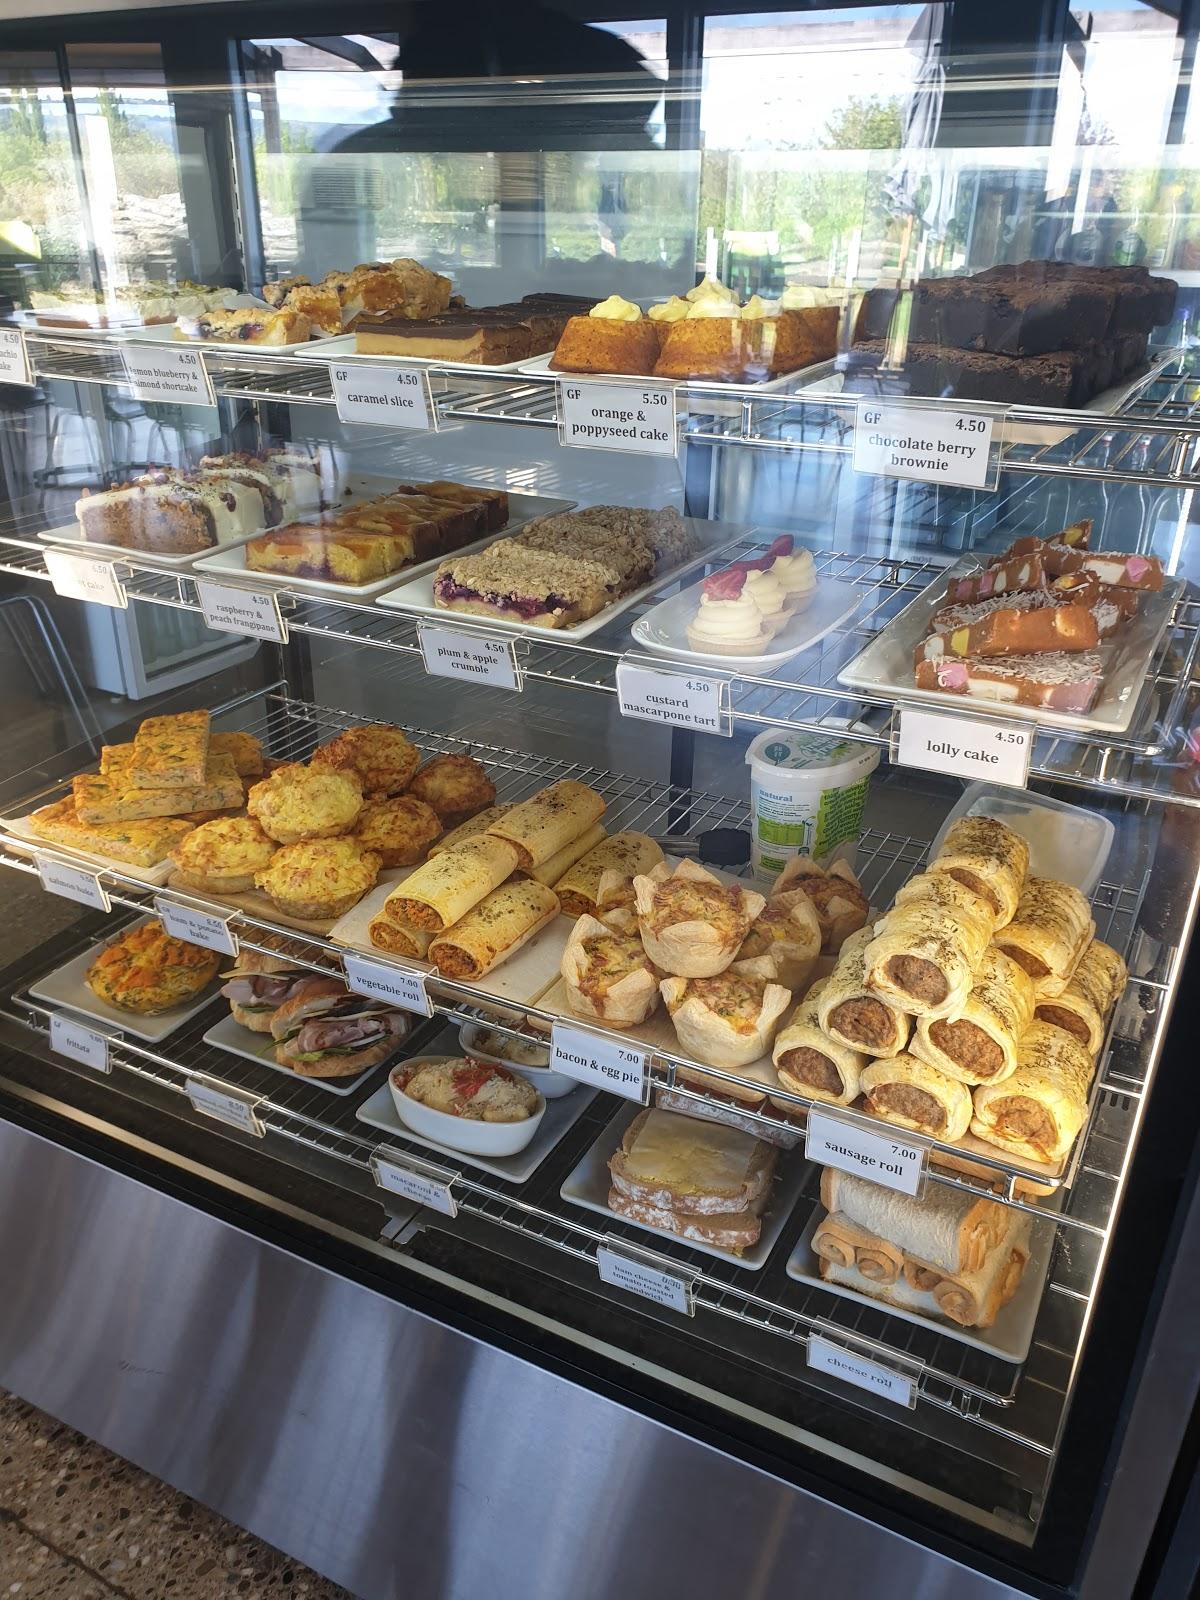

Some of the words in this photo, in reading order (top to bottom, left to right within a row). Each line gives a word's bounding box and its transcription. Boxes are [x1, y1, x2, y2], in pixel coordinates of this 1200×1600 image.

[178, 354, 197, 365] 4.50
[129, 366, 153, 377] lemon
[153, 368, 190, 380] blueberry
[192, 372, 198, 380] &
[336, 371, 348, 381] GF
[396, 373, 418, 386] 4.50
[134, 380, 160, 389] almond
[162, 381, 198, 392] shortcake
[347, 393, 389, 405] caramel
[390, 396, 414, 408] slice
[567, 389, 581, 399] GF
[642, 393, 667, 405] 5.50
[591, 408, 634, 422] orange
[636, 410, 646, 421] &
[864, 412, 881, 424] GF
[955, 419, 986, 433] 4.50
[572, 423, 637, 438] poppyseed
[640, 429, 669, 441] cake
[869, 433, 933, 451] chocolate
[937, 440, 976, 458] berry
[891, 453, 949, 470] brownie
[252, 596, 269, 605] 4.50
[210, 614, 232, 624] peach
[216, 604, 254, 618] raspberry
[256, 611, 263, 619] &
[484, 642, 505, 653] 4.50
[438, 647, 461, 659] plum
[463, 651, 471, 659] &
[472, 654, 498, 665] apple
[451, 661, 489, 674] crumble
[685, 681, 709, 692] 4.50
[646, 694, 689, 708] custard
[623, 703, 691, 722] mascarpone
[694, 715, 716, 726] tart
[995, 732, 1024, 745] 4.50
[927, 740, 960, 758] lolly
[964, 750, 999, 764] cake
[759, 789, 793, 802] natural
[356, 976, 401, 996] vegetable
[402, 991, 420, 1002] roll
[400, 976, 418, 988] 7.00
[66, 1038, 90, 1053] frittata
[618, 1050, 639, 1064] 7.00
[556, 1047, 587, 1066] bacon
[590, 1059, 599, 1070] &
[601, 1065, 620, 1080] egg
[622, 1072, 640, 1084] pie
[825, 1141, 876, 1165] sausage
[879, 1161, 903, 1176] roll
[891, 1145, 916, 1160] 7.00
[390, 1174, 431, 1194] macaroni
[614, 1265, 632, 1276] ham
[634, 1273, 662, 1288] cheese
[613, 1271, 641, 1286] tomato
[643, 1284, 674, 1299] toasted
[624, 1284, 663, 1301] sandwich
[827, 1357, 868, 1377] cheese
[870, 1375, 892, 1388] roll
